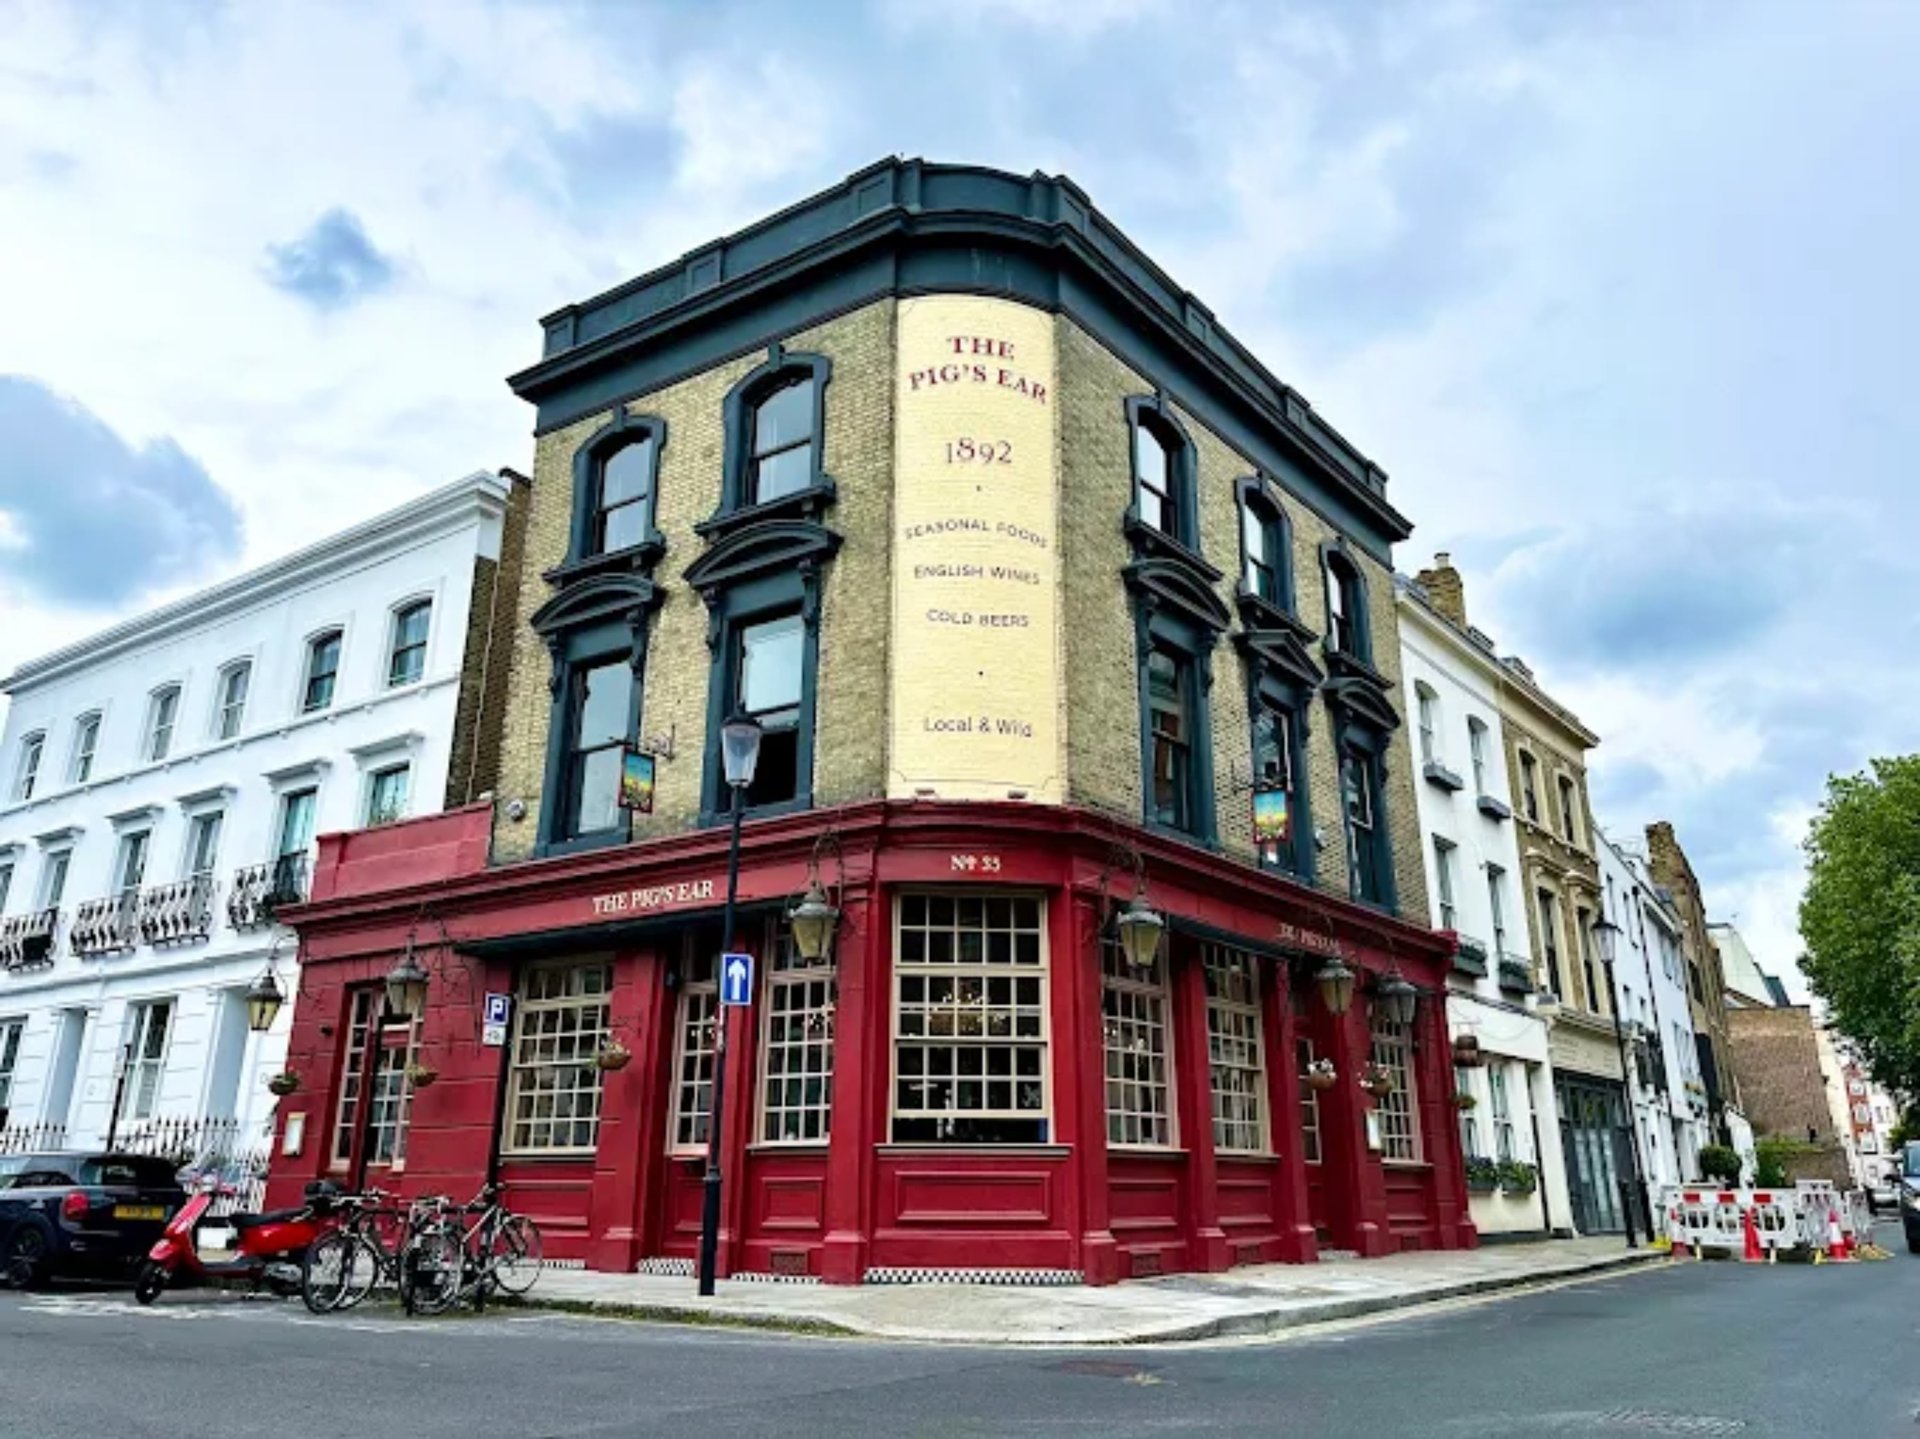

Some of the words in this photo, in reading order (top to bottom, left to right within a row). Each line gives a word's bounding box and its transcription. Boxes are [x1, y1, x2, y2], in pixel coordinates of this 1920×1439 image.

[947, 335, 1014, 361] THE
[909, 363, 987, 390] PIG'S
[997, 368, 1046, 405] EAR
[946, 437, 1012, 464] 1892
[904, 517, 991, 540] SEASONAL
[913, 563, 984, 579] ENGLISH
[990, 566, 1040, 585] WINES
[926, 608, 972, 625] COLD
[979, 614, 1029, 627] BEERS
[924, 716, 972, 732] Local
[978, 716, 991, 733] &
[996, 718, 1033, 738] Wild
[592, 892, 628, 914] THE
[677, 880, 713, 902] EAR
[491, 998, 503, 1020] P
